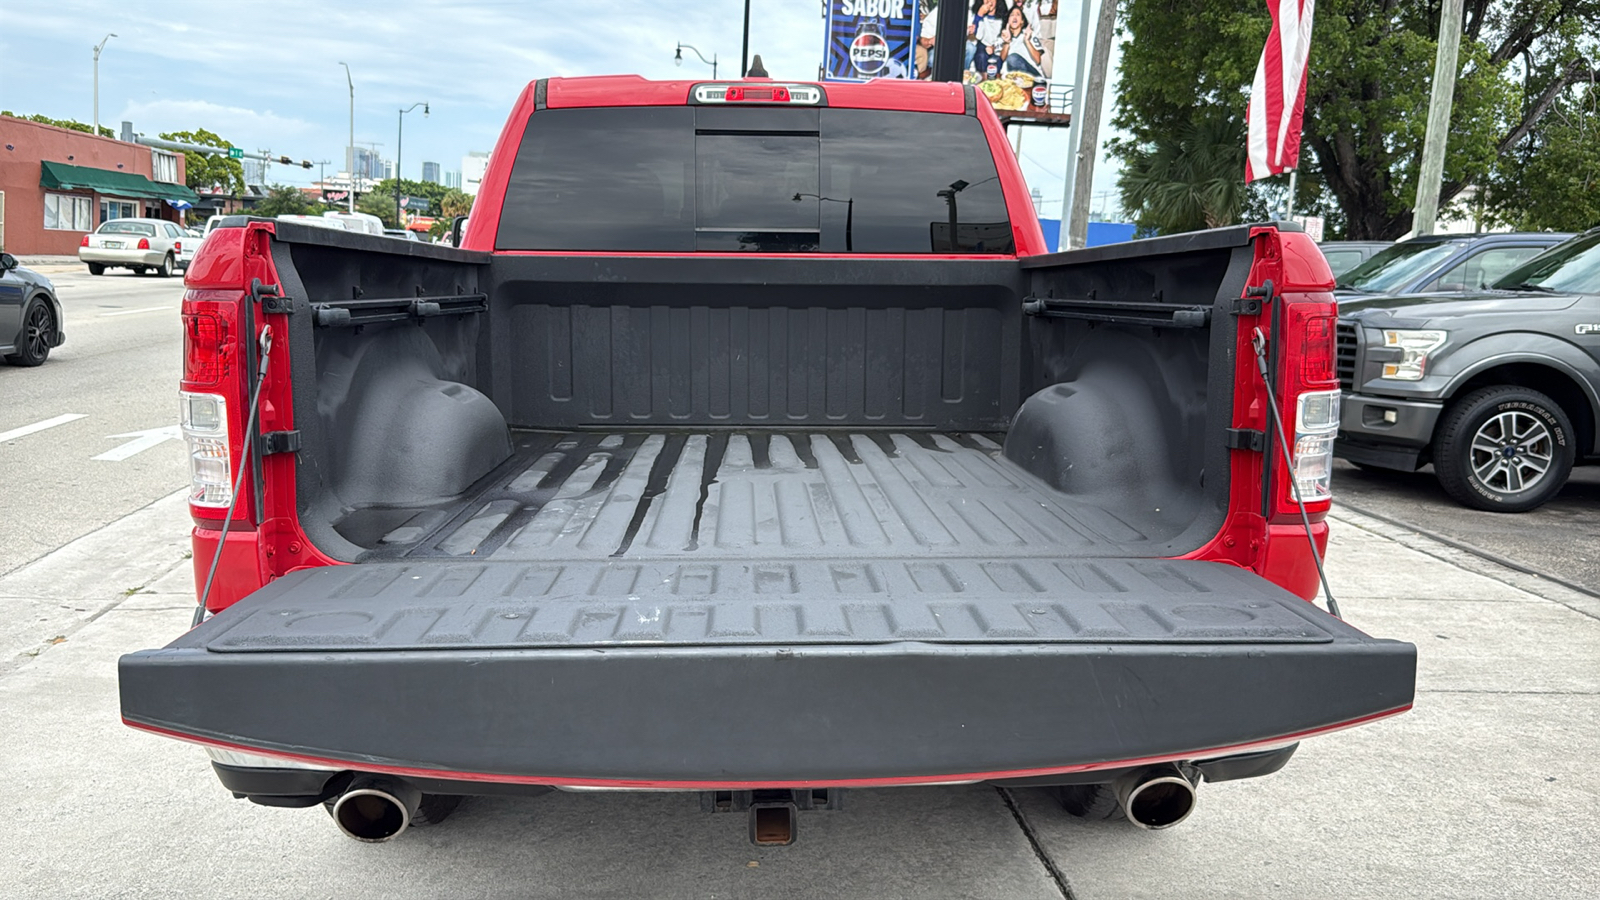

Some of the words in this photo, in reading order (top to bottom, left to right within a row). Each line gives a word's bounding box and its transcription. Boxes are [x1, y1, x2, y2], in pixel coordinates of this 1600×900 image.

[841, 0, 904, 19] SABOR
[853, 48, 886, 59] PEPSI
[1498, 402, 1557, 426] TERRAMAX
